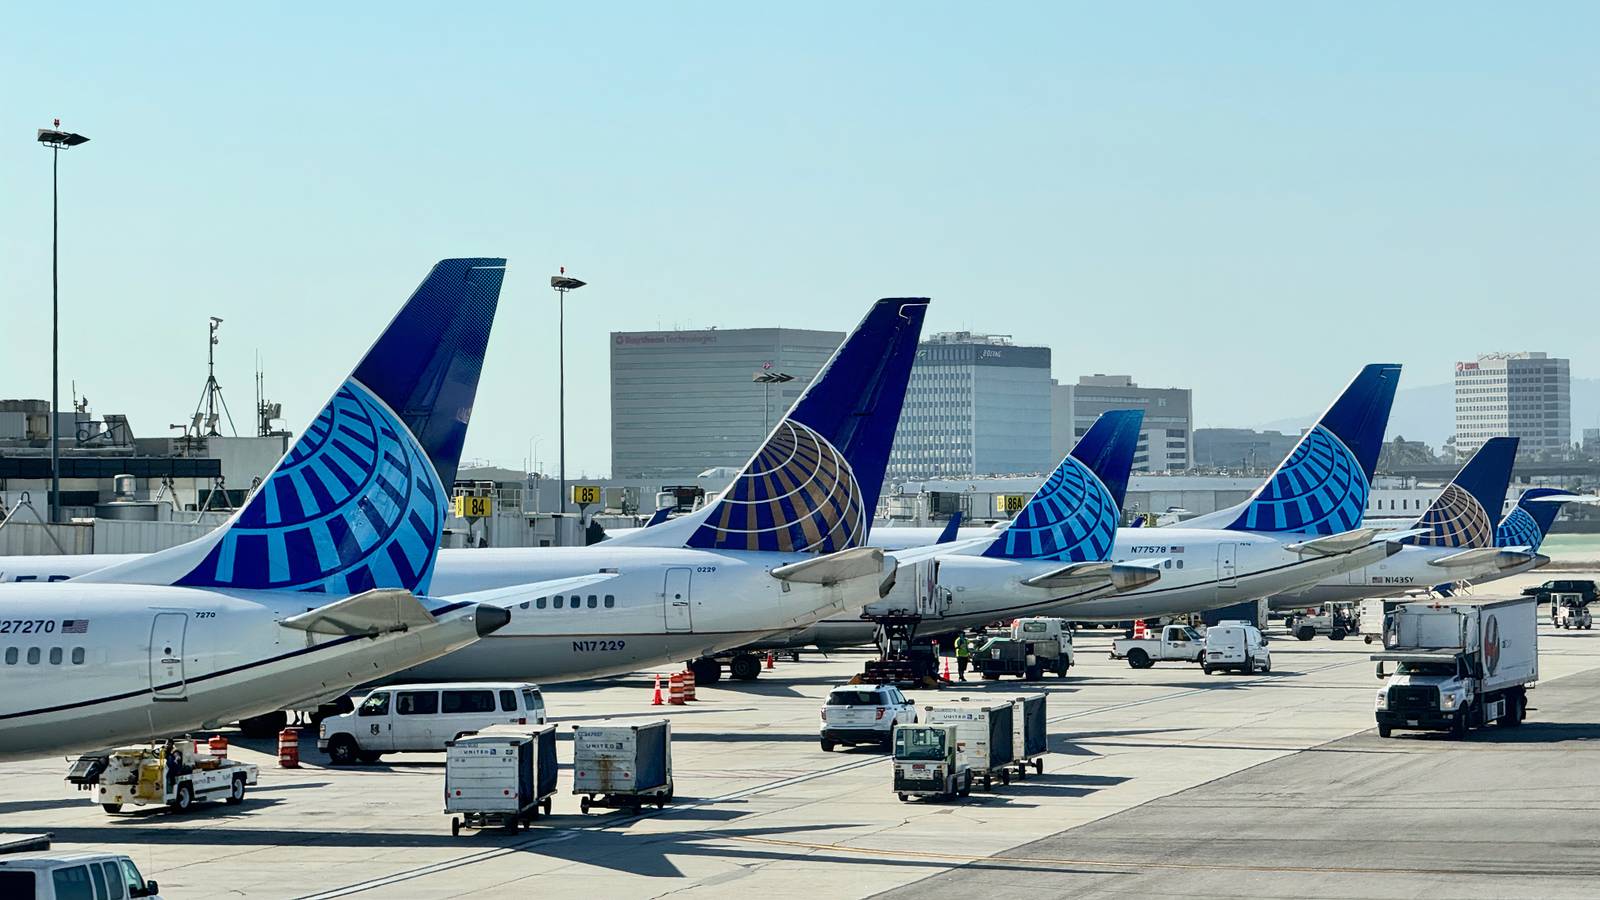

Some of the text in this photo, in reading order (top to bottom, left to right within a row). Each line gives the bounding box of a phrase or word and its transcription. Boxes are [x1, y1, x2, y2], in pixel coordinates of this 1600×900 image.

[582, 488, 594, 502] 85
[472, 499, 485, 515] 84
[1007, 497, 1023, 510] 86A
[195, 611, 216, 619] 7270
[0, 620, 56, 633] 27270
[572, 640, 626, 652] N17229
